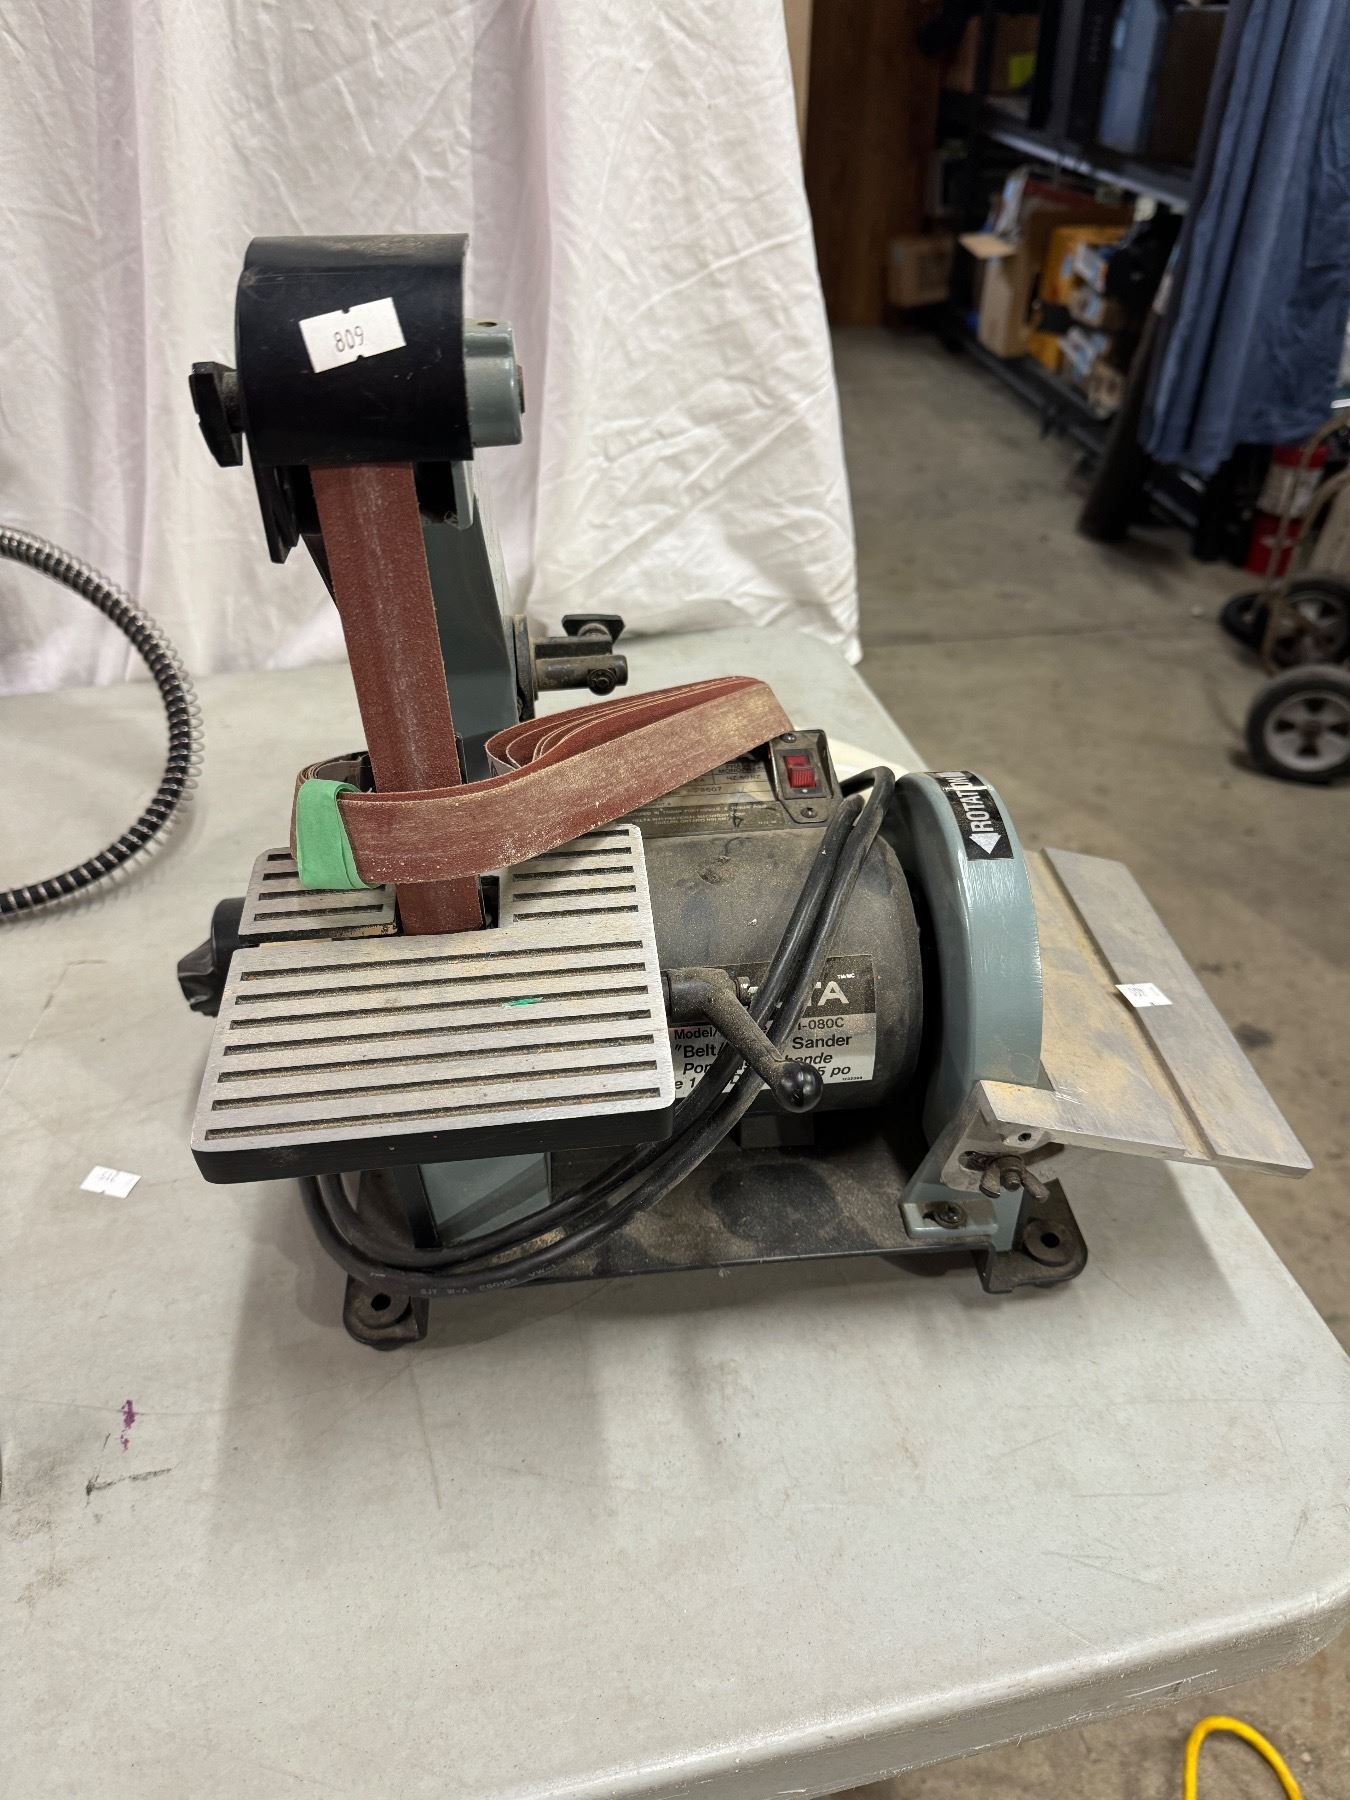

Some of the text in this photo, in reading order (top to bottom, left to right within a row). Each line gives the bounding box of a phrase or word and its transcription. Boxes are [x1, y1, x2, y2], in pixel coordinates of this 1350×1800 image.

[333, 325, 365, 353] 809
[792, 1034, 853, 1050] Sander
[829, 1065, 851, 1078] po
